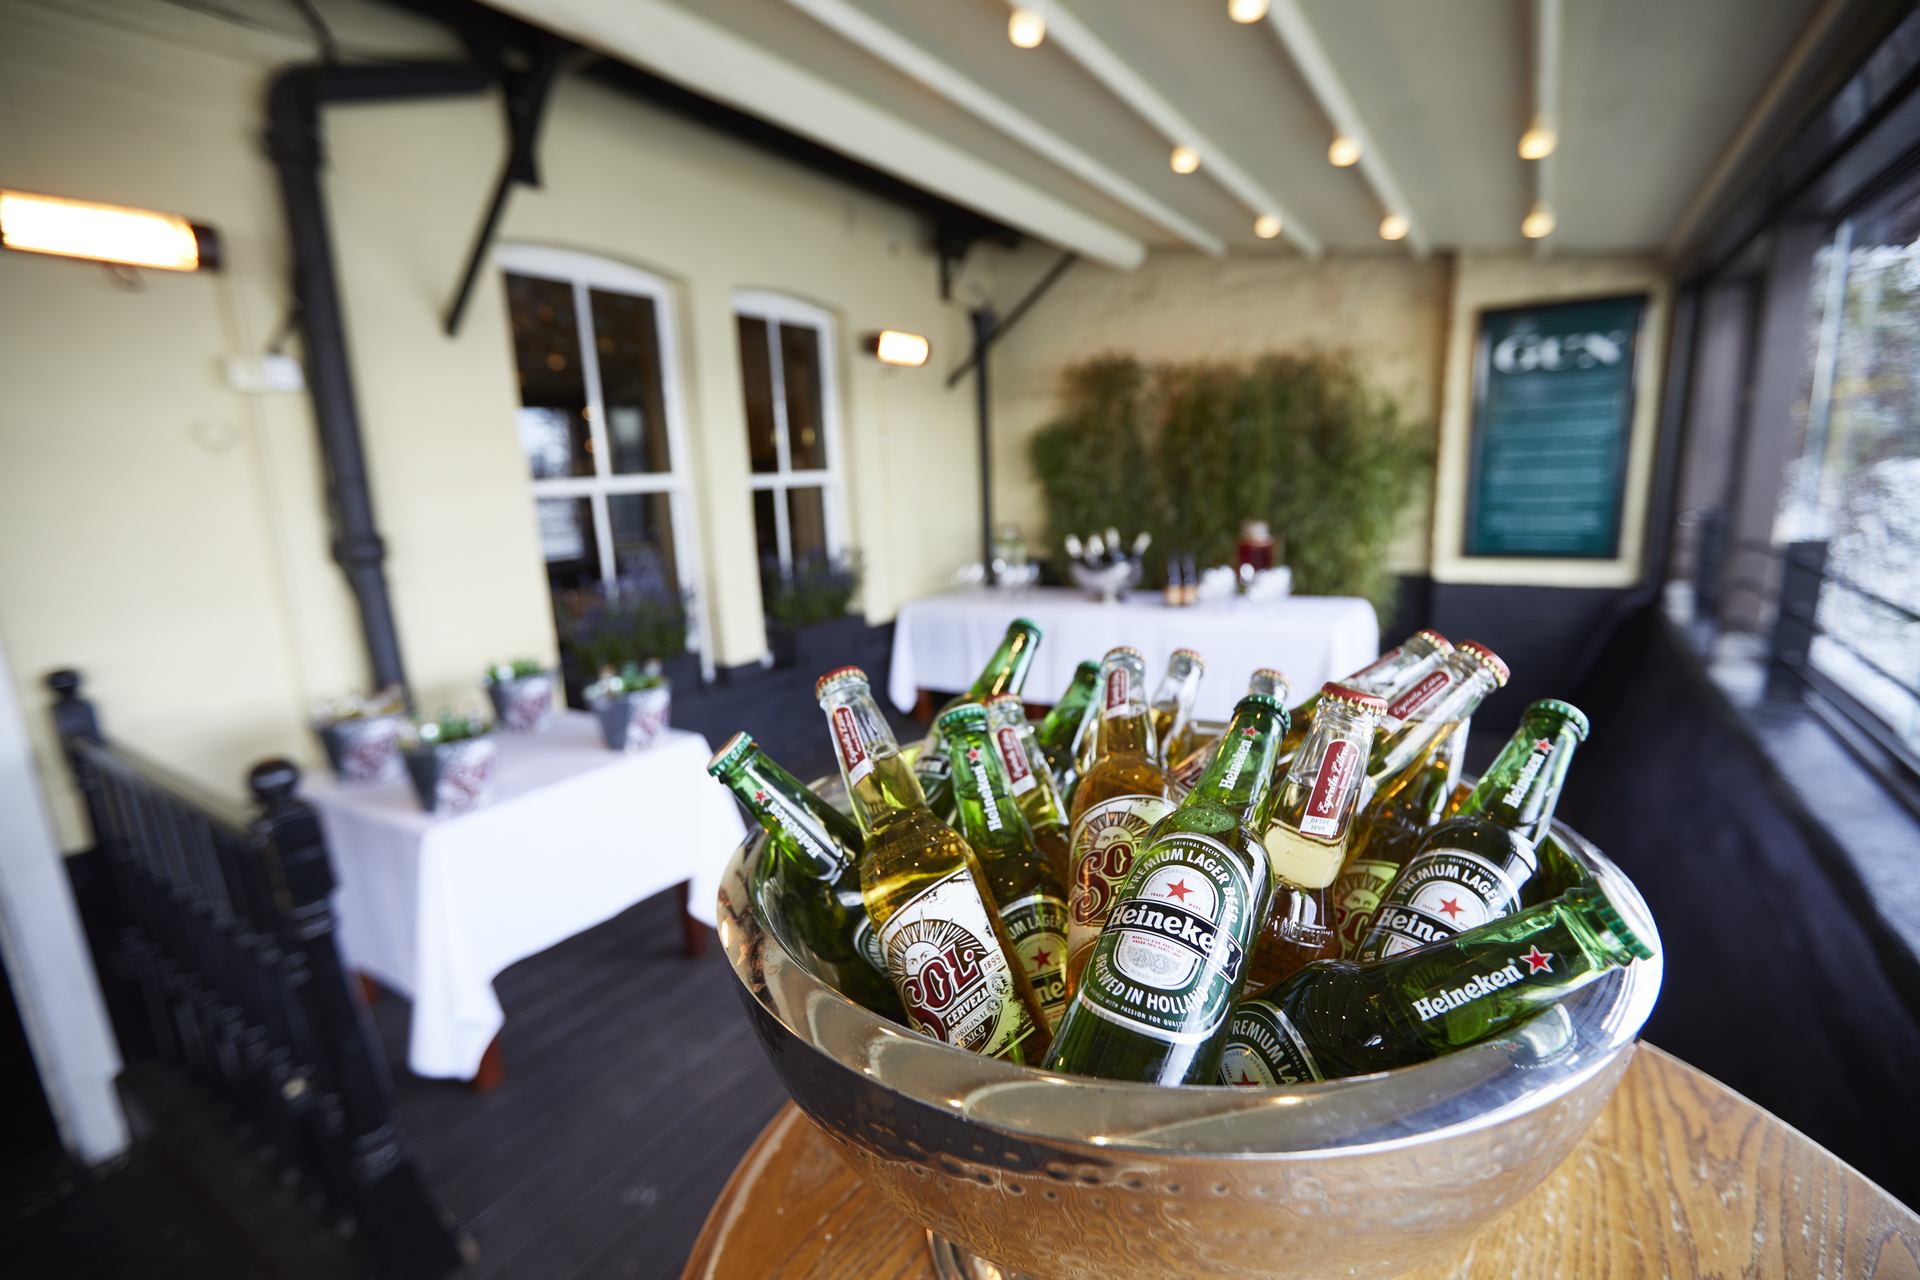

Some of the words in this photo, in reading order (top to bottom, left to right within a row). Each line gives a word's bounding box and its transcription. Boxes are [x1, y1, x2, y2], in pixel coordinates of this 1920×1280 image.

[1219, 739, 1253, 791] Heineken
[1502, 752, 1546, 809] Heineken
[974, 764, 1003, 832] Heineken
[766, 800, 823, 859] Heineken
[1073, 840, 1142, 926] SO
[1127, 848, 1184, 890] PREMIUM
[1187, 849, 1230, 885] LAGER
[1398, 863, 1460, 896] PREMIUM
[1377, 907, 1450, 942] Heine
[901, 943, 981, 1044] SOL
[1095, 953, 1125, 997] BREWED
[1124, 986, 1145, 1005] IN
[1412, 964, 1524, 1022] Heineken
[946, 987, 990, 1027] CERVEZA
[1120, 1005, 1146, 1019] PASSION
[1148, 1015, 1161, 1025] FOR
[1232, 1019, 1285, 1065] REMIUM
